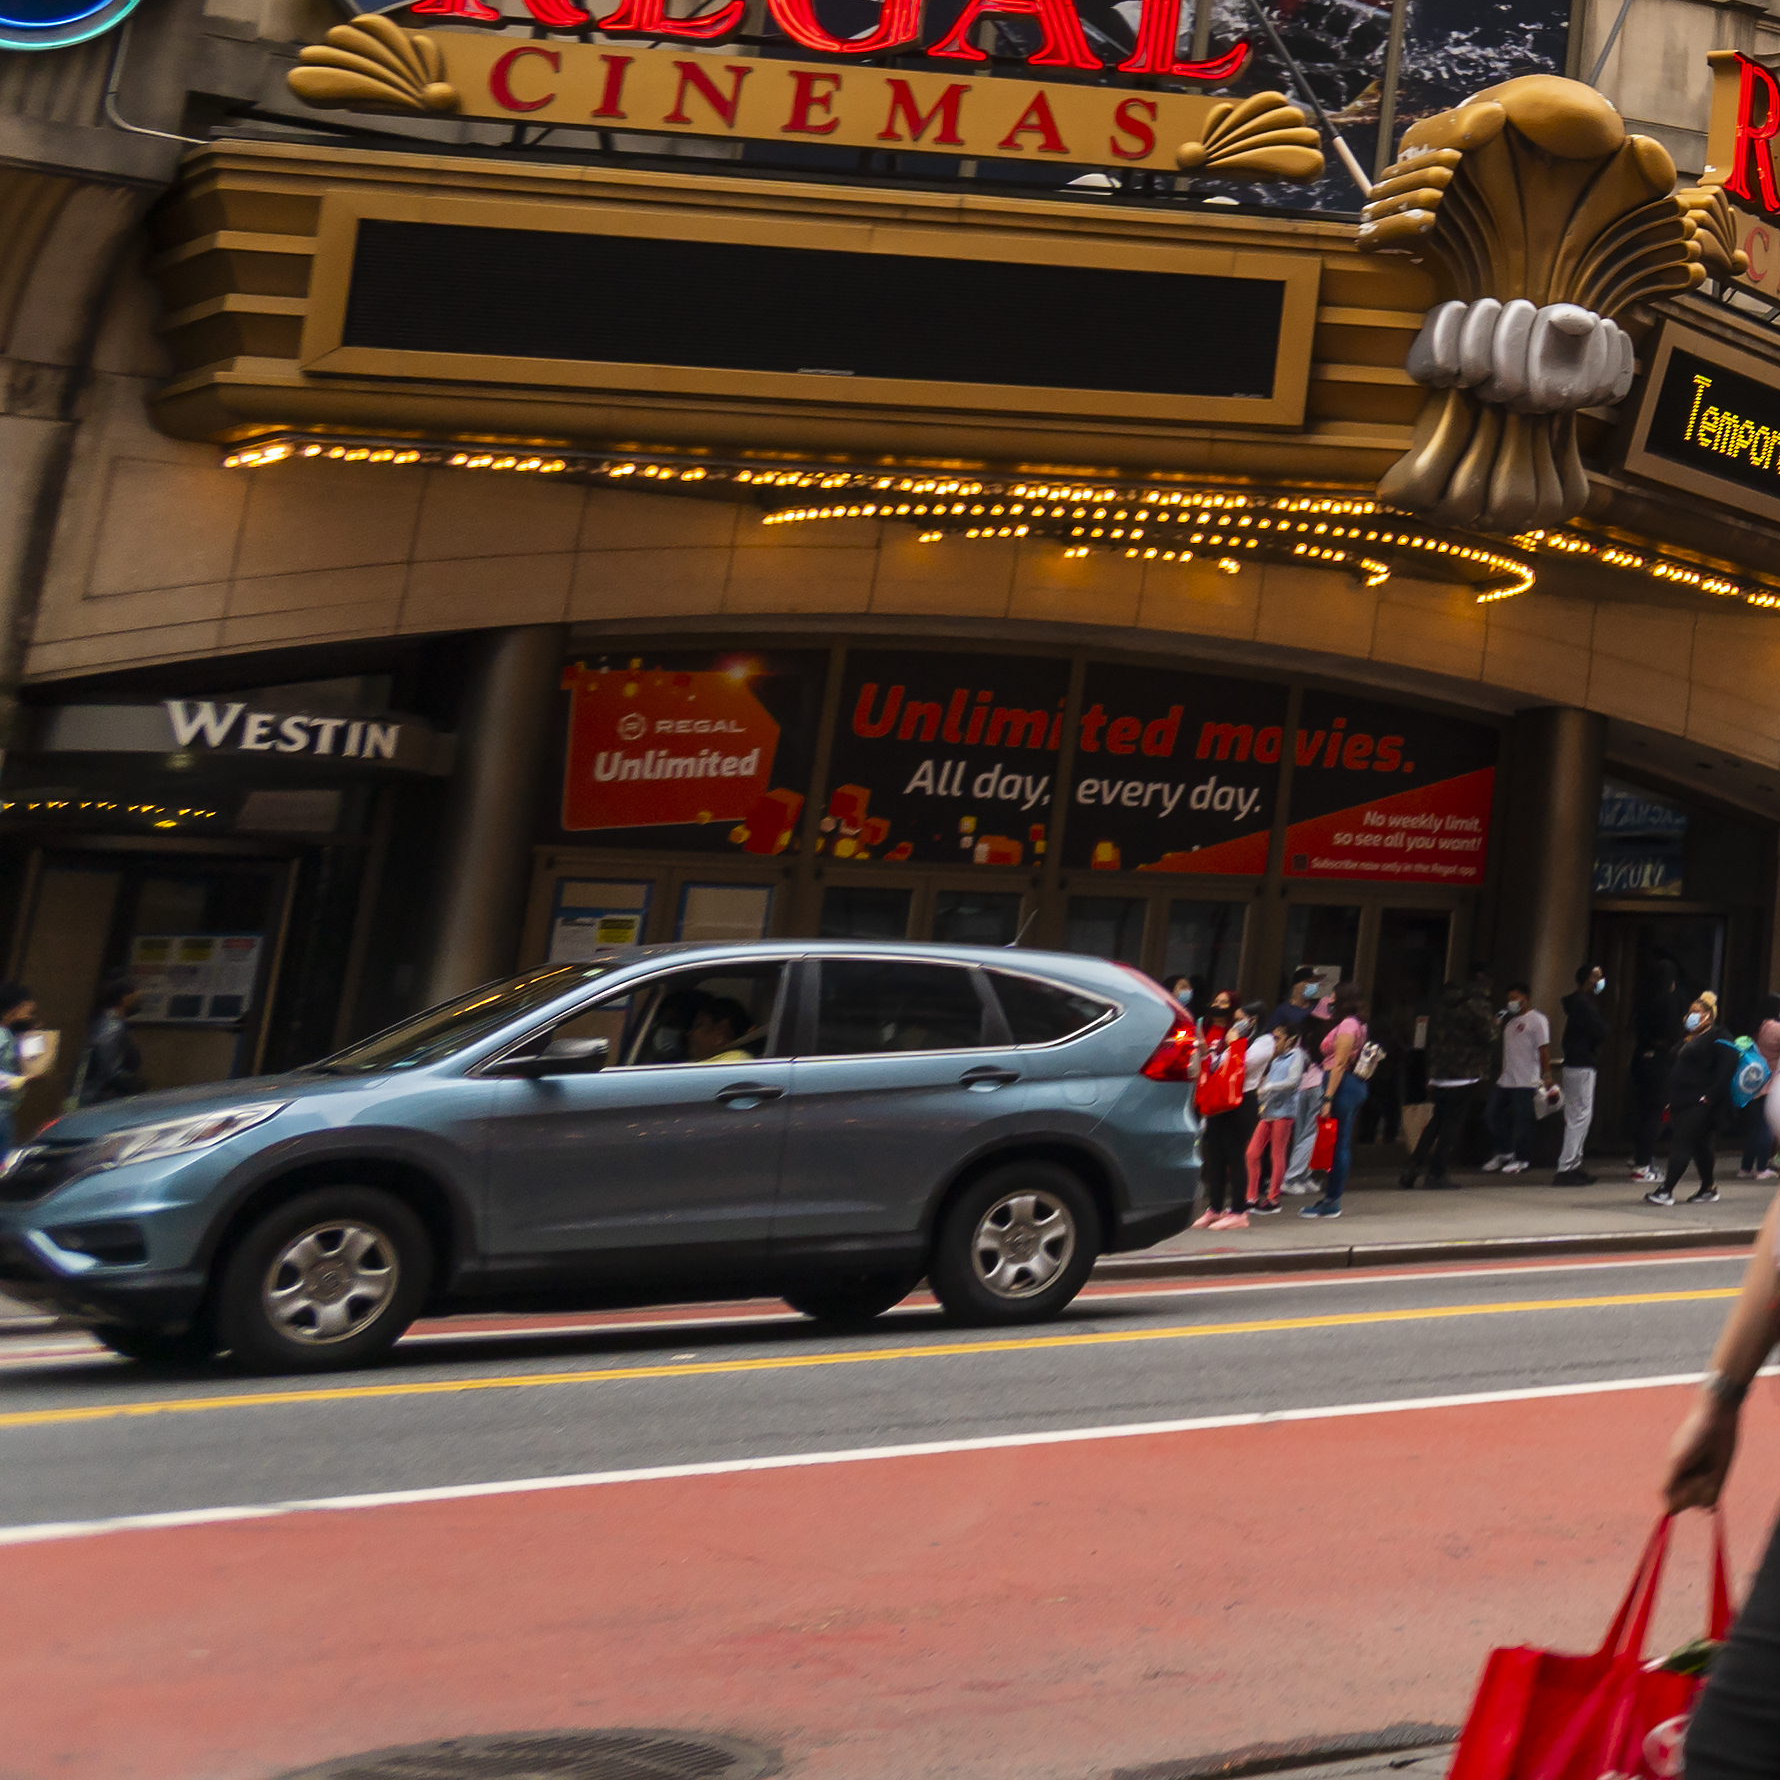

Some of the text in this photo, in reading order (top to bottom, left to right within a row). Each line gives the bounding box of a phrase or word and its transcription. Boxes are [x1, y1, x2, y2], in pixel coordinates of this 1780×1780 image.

[490, 46, 1160, 162] CINEMAS
[163, 699, 401, 760] WESTIN
[653, 719, 747, 734] REGAL
[851, 681, 1415, 778] Unlimited movies.
[592, 746, 763, 784] Unlimited
[903, 757, 1264, 819] All day, every day.
[1332, 831, 1483, 853] so see all you want!
[1362, 810, 1386, 827] No
[1387, 812, 1443, 834] weekly
